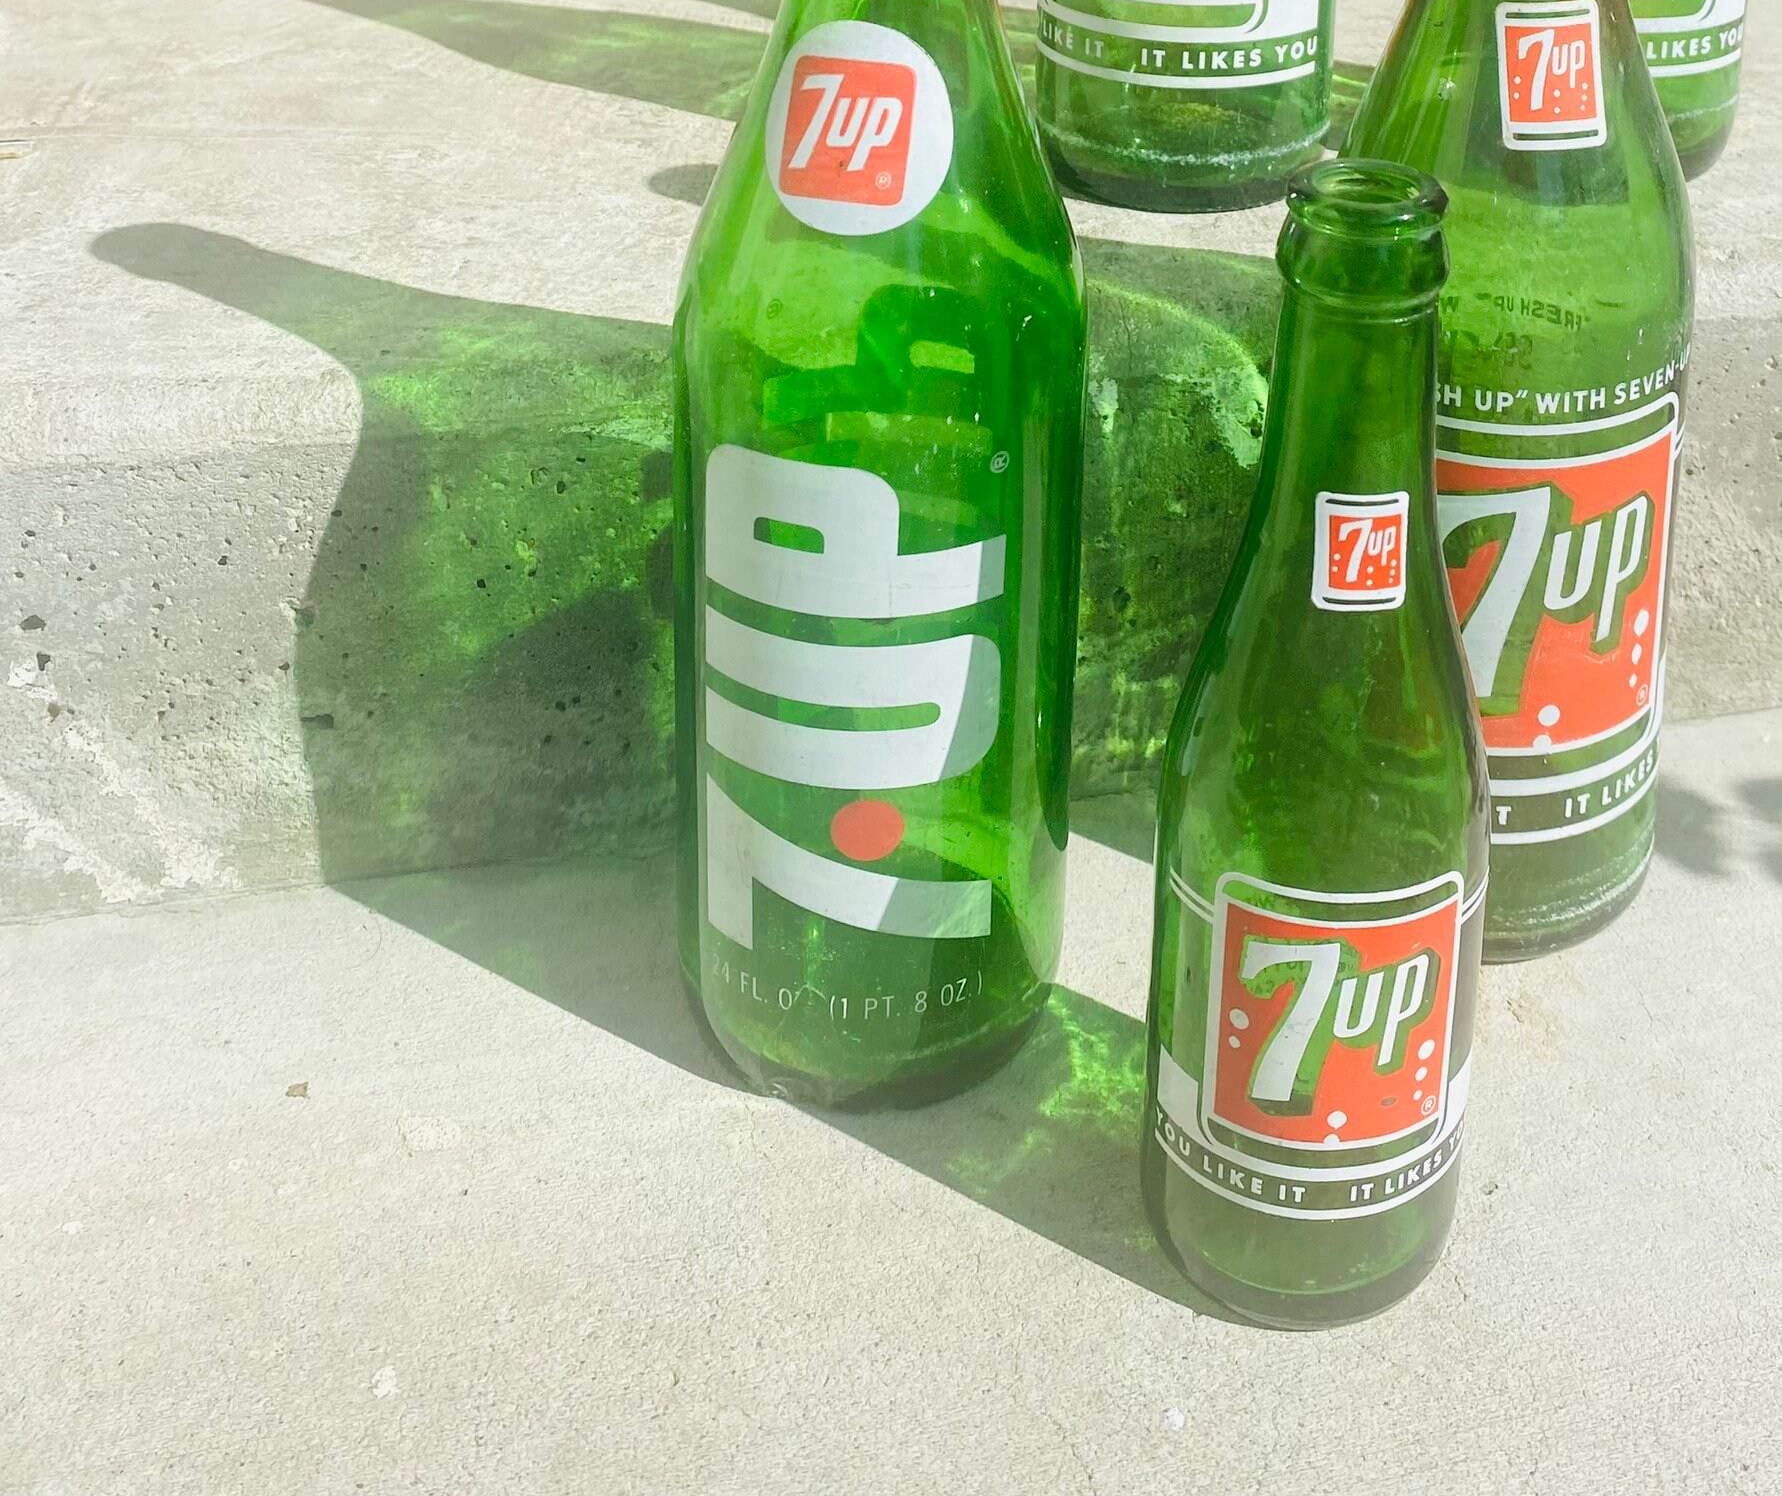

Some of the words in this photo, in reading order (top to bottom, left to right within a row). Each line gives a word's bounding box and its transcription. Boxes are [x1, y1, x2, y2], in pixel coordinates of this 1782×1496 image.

[1042, 18, 1075, 50] LIKE
[1084, 37, 1105, 58] IT
[1140, 47, 1167, 68] IT
[1181, 48, 1263, 70] LIKES
[1273, 34, 1319, 65] YOU
[1645, 35, 1712, 60] LIKES
[1718, 21, 1744, 50] YOU
[1535, 387, 1606, 415] WITH
[1564, 793, 1591, 818] IT
[1601, 749, 1654, 806] LIKES
[740, 971, 769, 1004] FL.
[863, 995, 901, 1020] PT.
[914, 990, 928, 1013] 8
[1155, 1106, 1191, 1157] YOU
[1202, 1154, 1263, 1195] LIKE
[1278, 1183, 1307, 1204] IT
[1349, 1182, 1376, 1203] IT
[1383, 1149, 1444, 1196] LIKES
